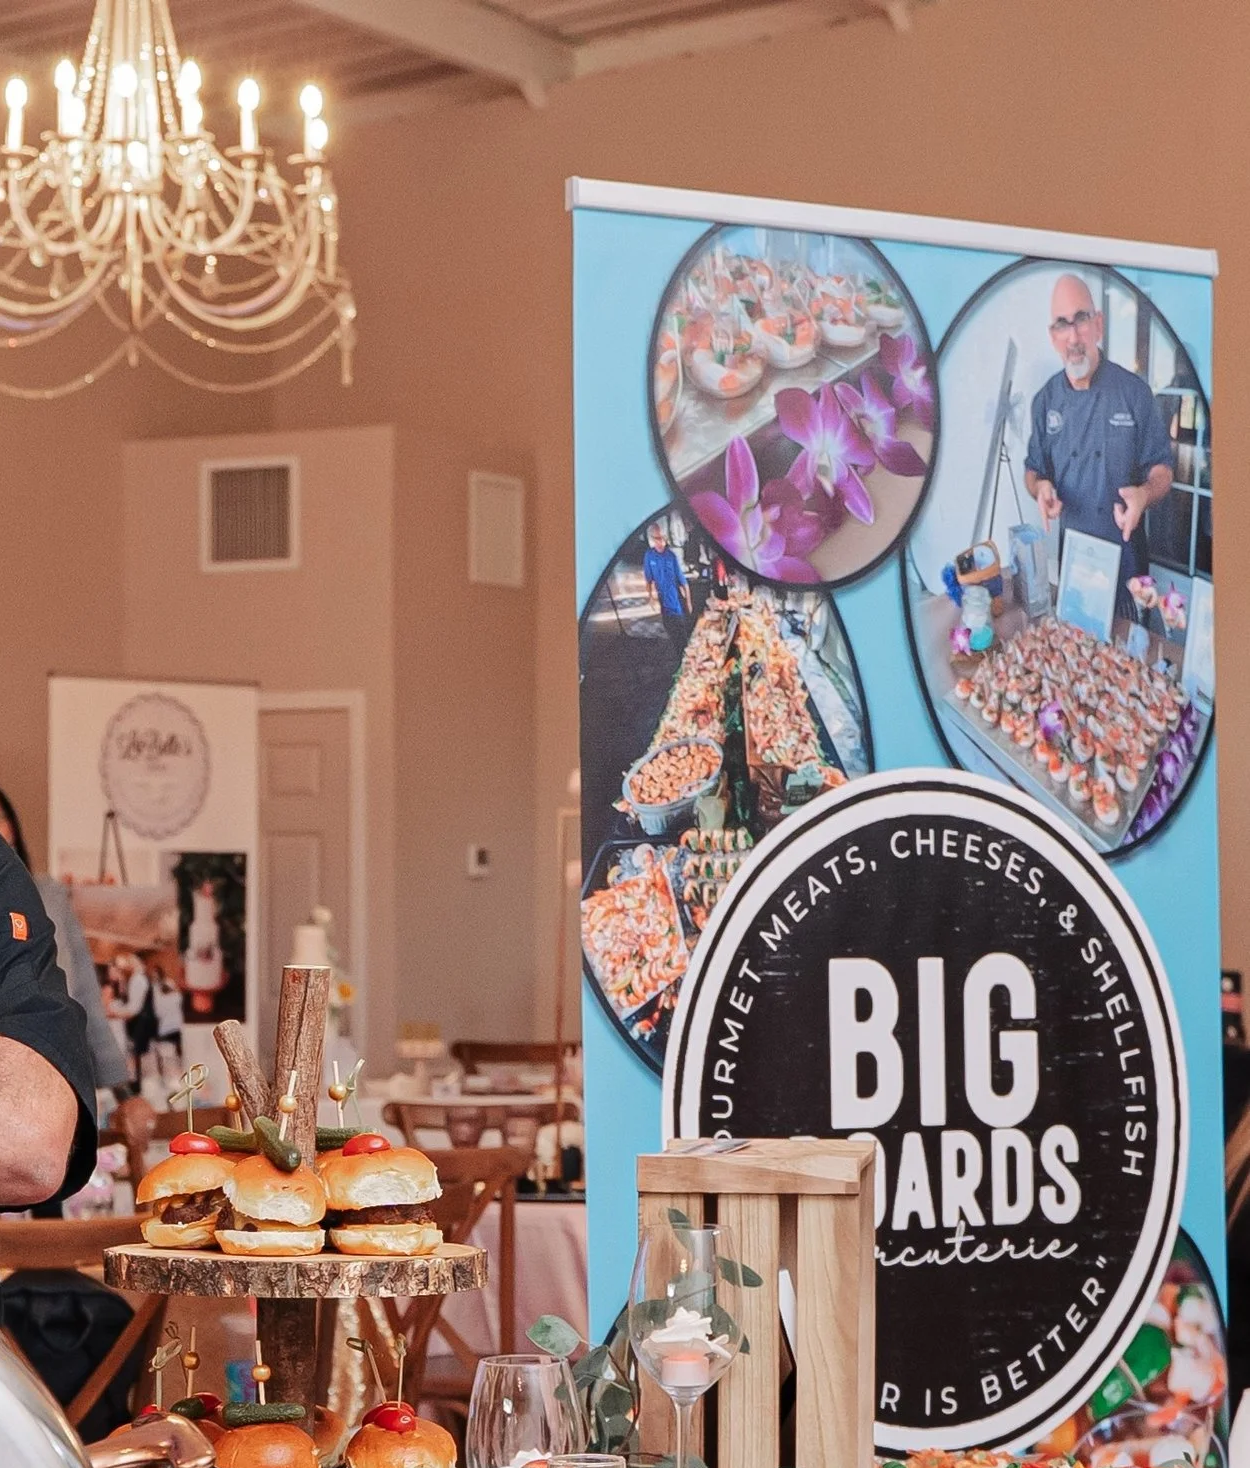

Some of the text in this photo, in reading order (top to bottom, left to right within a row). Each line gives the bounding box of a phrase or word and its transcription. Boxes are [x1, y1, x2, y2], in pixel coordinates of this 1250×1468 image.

[711, 827, 1147, 1176] URMET MEATS, CHEESES, & SHELLFISH
[828, 951, 1040, 1130] BIG
[847, 1124, 1082, 1231] ARDS
[874, 1219, 1079, 1267] rcuterie
[924, 1254, 1107, 1417] IS BETTER"
